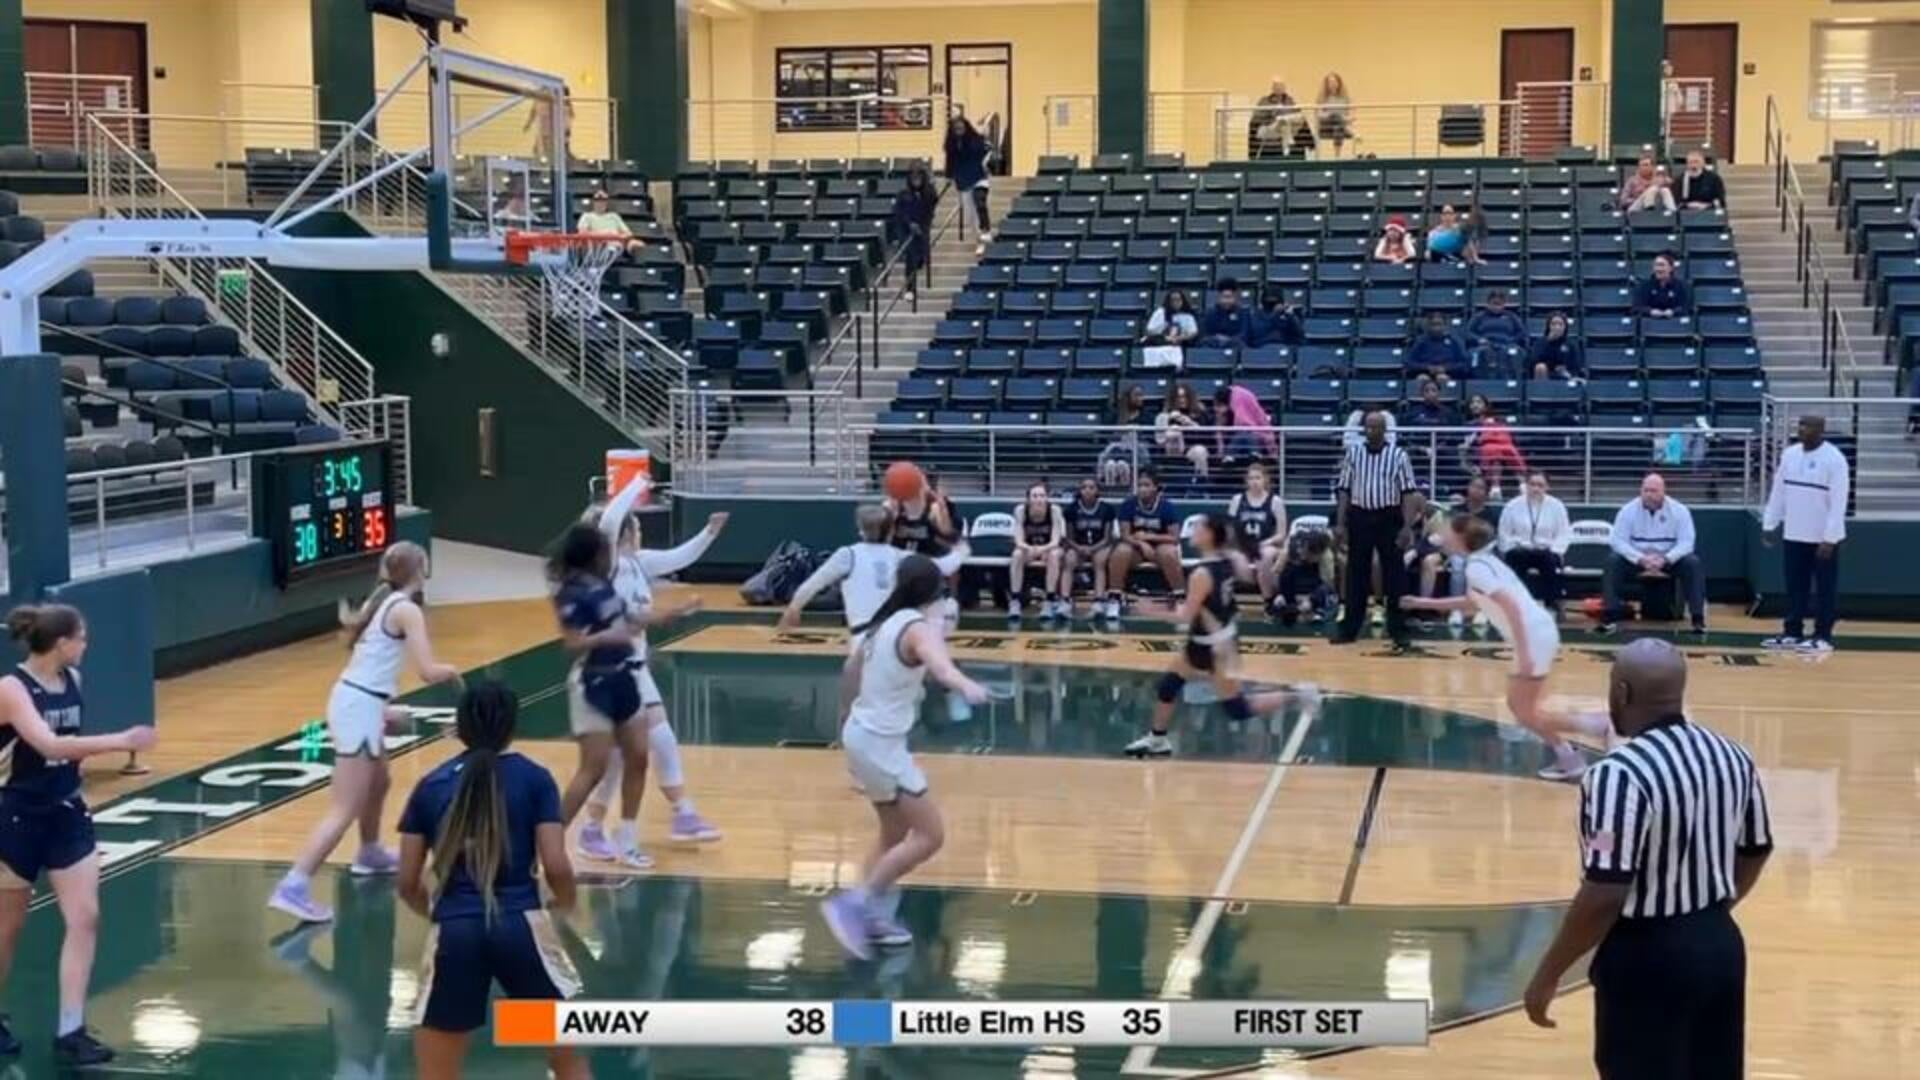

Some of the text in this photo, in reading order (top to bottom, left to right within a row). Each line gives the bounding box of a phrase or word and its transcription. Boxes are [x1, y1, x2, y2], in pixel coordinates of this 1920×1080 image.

[324, 457, 362, 495] 3:45
[295, 523, 317, 561] 38
[334, 512, 343, 539] 3
[363, 510, 385, 547] 35
